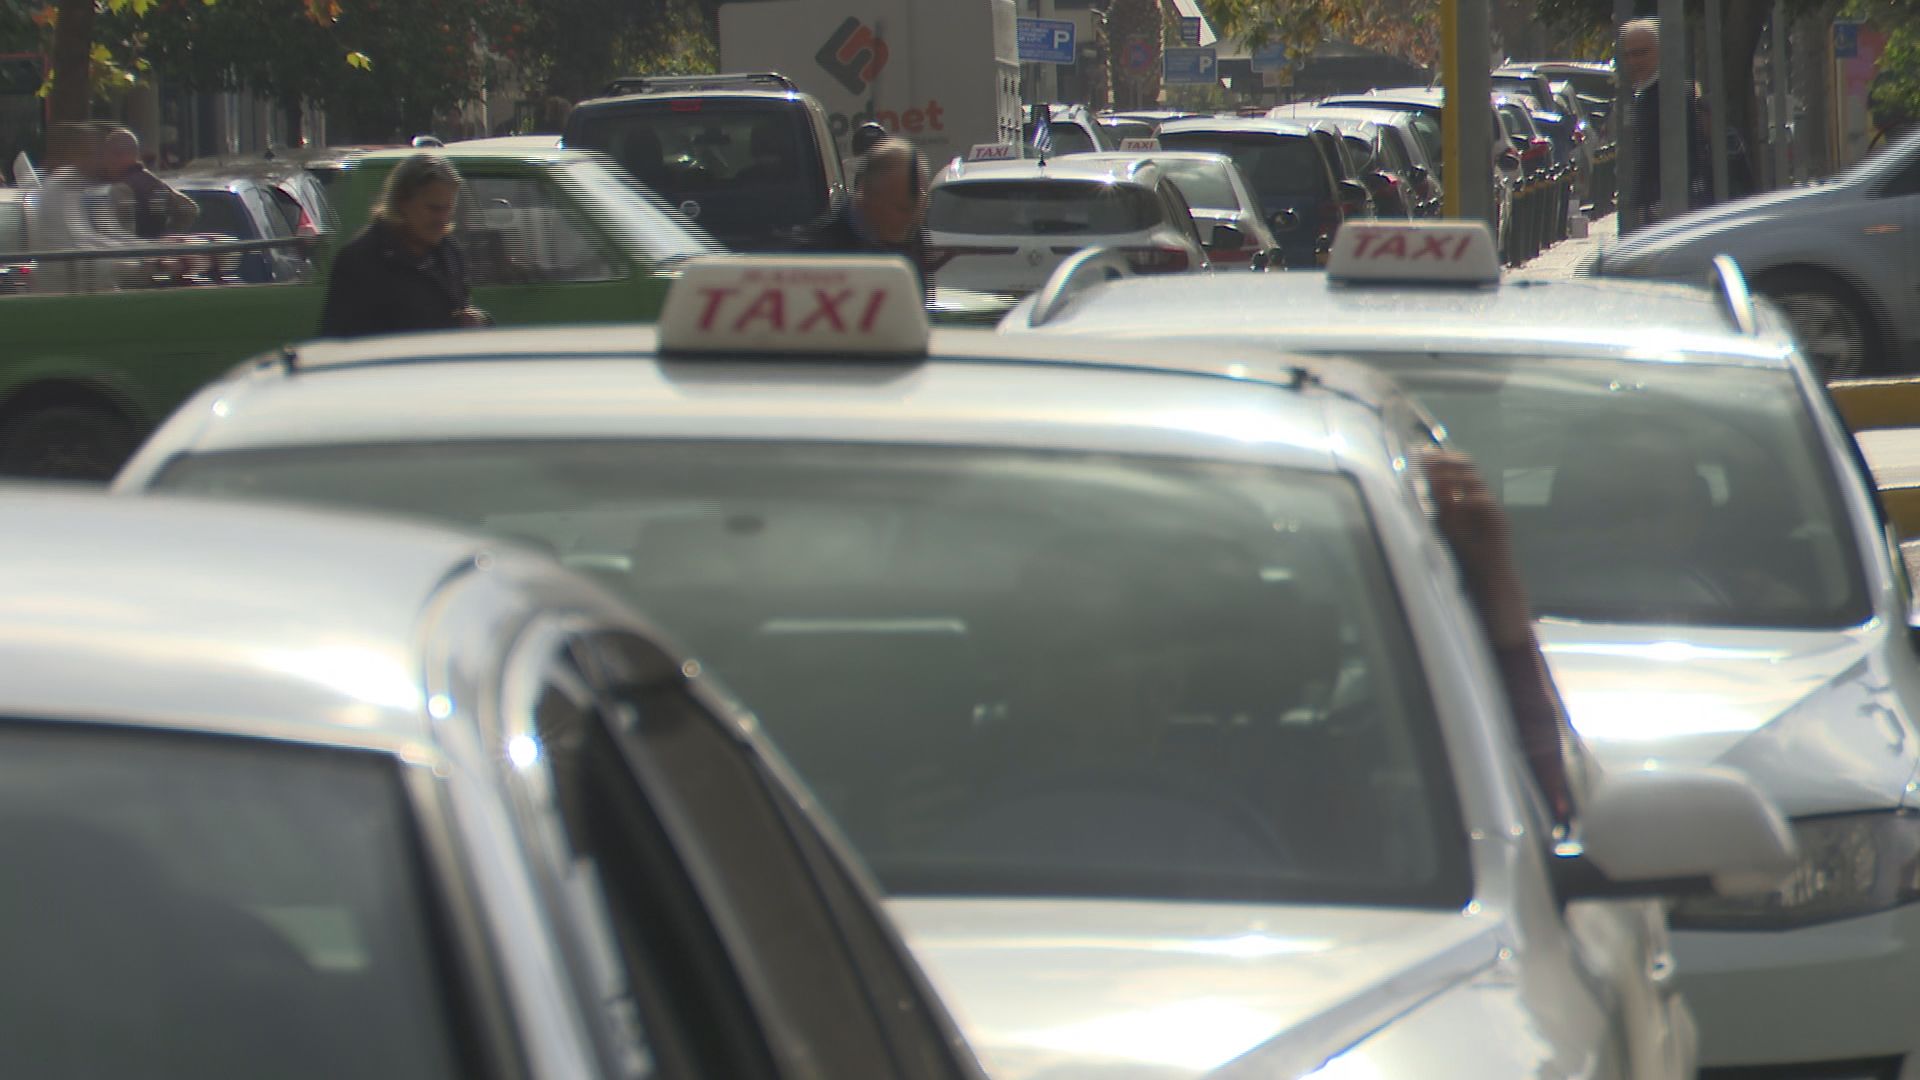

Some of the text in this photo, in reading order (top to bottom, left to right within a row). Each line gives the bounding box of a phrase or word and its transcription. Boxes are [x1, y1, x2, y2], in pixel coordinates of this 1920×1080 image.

[1053, 29, 1071, 49] P
[975, 146, 1009, 158] TAXI
[1127, 141, 1154, 150] TAXI
[1352, 232, 1473, 262] TAXI
[696, 286, 888, 333] TAXI
